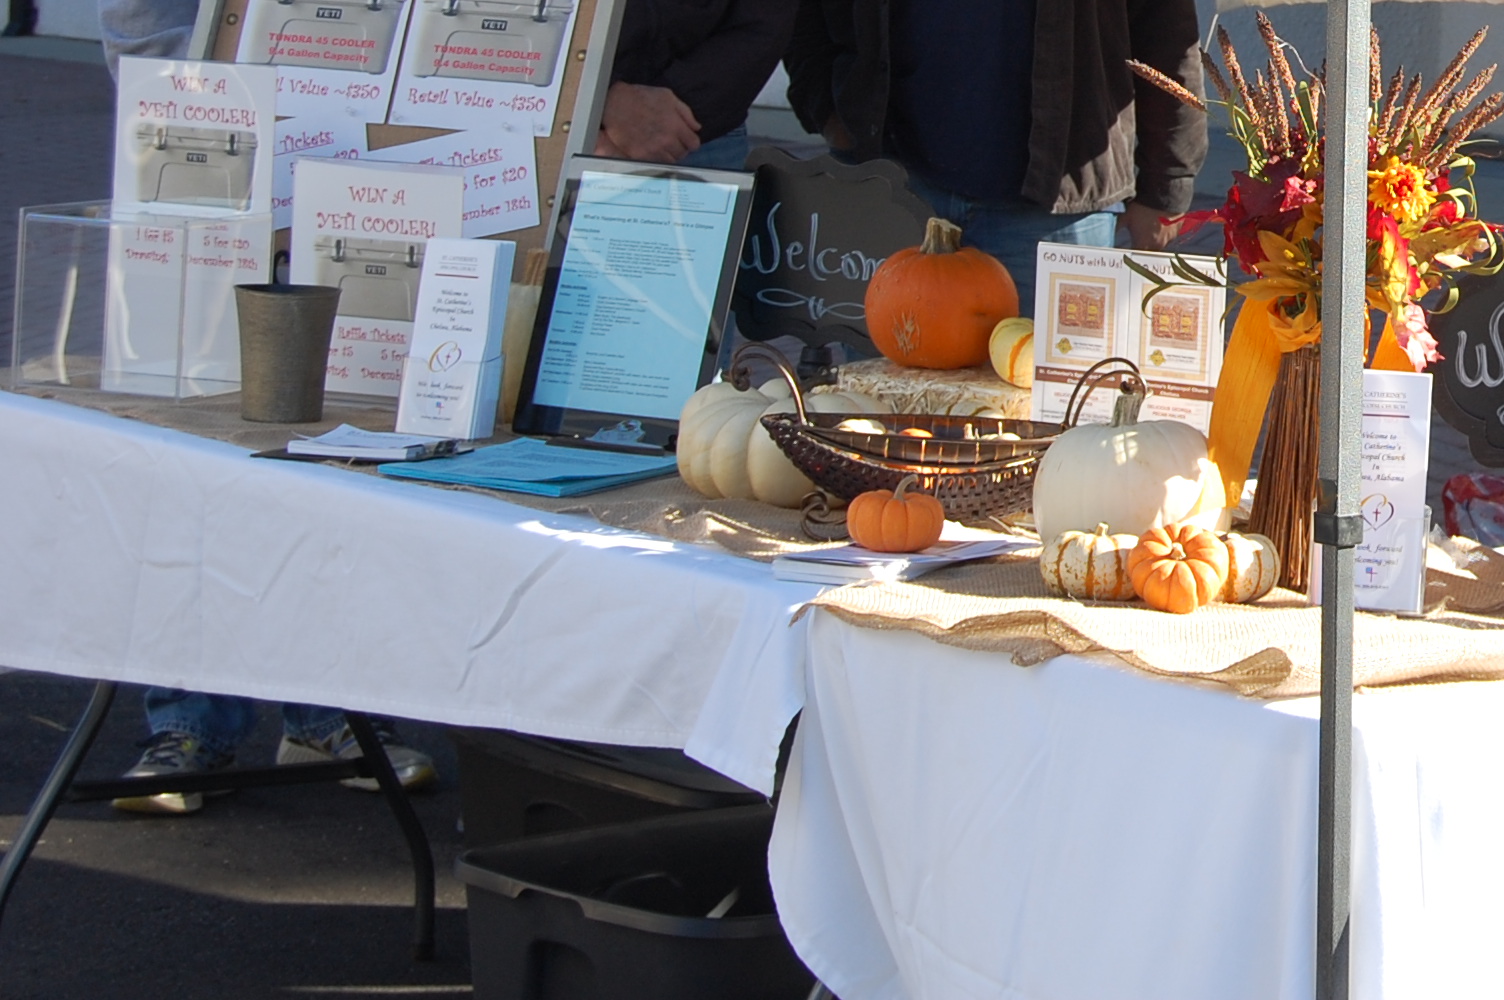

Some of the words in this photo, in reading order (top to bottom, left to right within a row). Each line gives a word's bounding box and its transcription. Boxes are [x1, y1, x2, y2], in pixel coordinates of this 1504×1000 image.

[318, 8, 341, 18] YETI
[483, 20, 506, 30] YETI
[269, 32, 312, 45] TUNDRA
[315, 36, 328, 46] 45
[332, 38, 376, 49] COOLER
[287, 48, 320, 59] Gallon
[323, 51, 369, 64] Capacity
[434, 44, 478, 56] TUNDRA
[481, 48, 494, 57] 45
[497, 50, 542, 61] COOLER
[452, 61, 485, 71] Gallon
[489, 63, 535, 76] Capacity
[170, 75, 209, 93] WIN
[213, 79, 226, 94] A
[290, 78, 329, 96] Value
[408, 88, 448, 105] Retail
[454, 91, 494, 108] Value
[139, 101, 177, 118] YETI
[183, 106, 256, 127] COOLER!
[473, 176, 496, 190] for
[502, 166, 527, 185] $20
[348, 186, 387, 203] WIN
[392, 189, 406, 205] A
[505, 198, 531, 213] 18th
[316, 211, 355, 231] YETI
[362, 215, 436, 239] COOLER!
[740, 202, 887, 282] Welcom
[1059, 253, 1085, 265] NUTS
[1087, 257, 1106, 268] with
[366, 266, 386, 276] YETI
